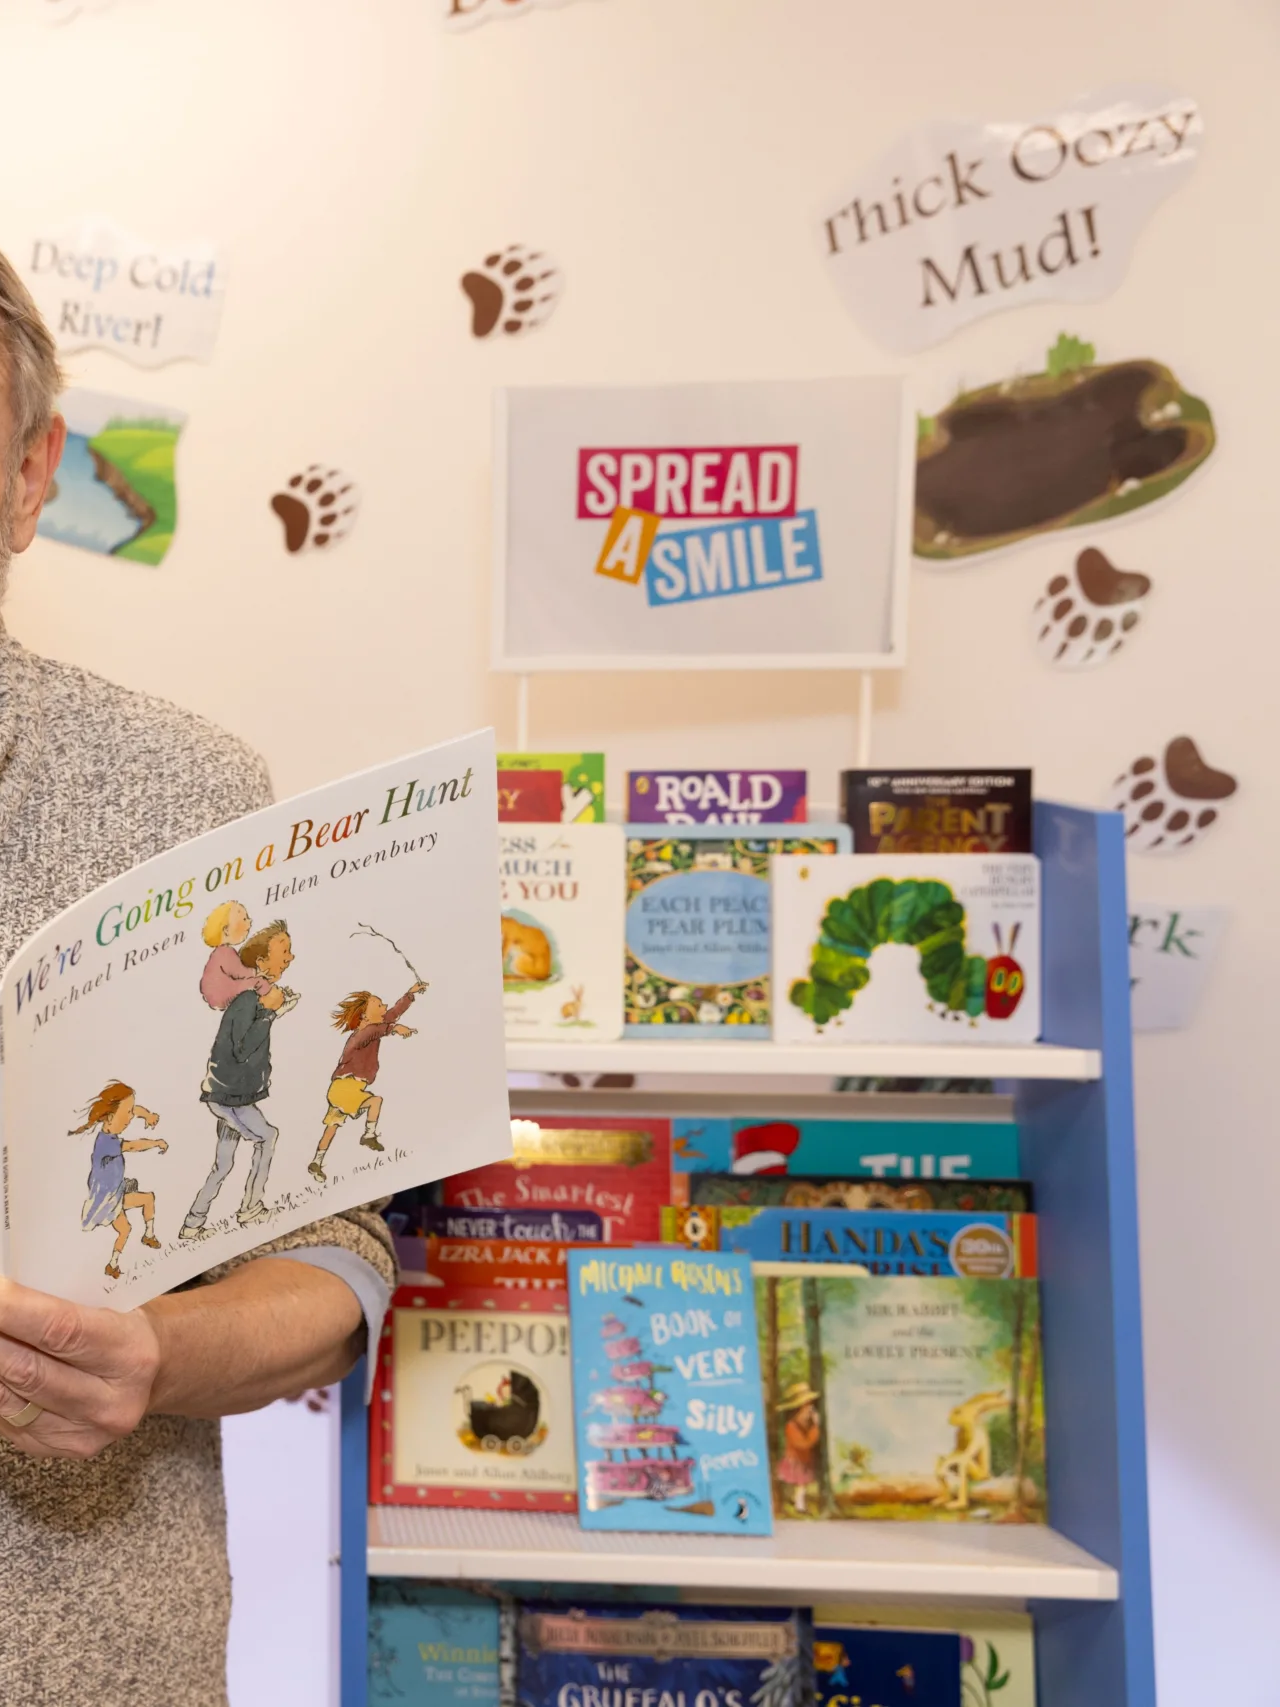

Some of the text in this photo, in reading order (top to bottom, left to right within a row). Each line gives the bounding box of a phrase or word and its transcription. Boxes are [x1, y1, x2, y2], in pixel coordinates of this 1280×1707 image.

[1010, 110, 1197, 183] Oozy
[31, 238, 217, 298] Deep Cold
[918, 203, 1104, 308] Mud!
[584, 451, 792, 515] SPREAD
[602, 514, 814, 600] A SMILE
[654, 772, 783, 811] ROALD
[868, 801, 1012, 836] PARENT
[13, 766, 475, 1016] We're Going on a Bear Hunt
[518, 881, 579, 901] YOU
[641, 896, 701, 914] EACH
[31, 830, 440, 1032] Michael Rosen Helen Oxenbury
[647, 918, 705, 936] PEAR
[515, 1175, 634, 1215] Smartest
[446, 1217, 497, 1237] NEVER
[503, 1212, 566, 1241] touch
[577, 1224, 597, 1239] THE
[781, 1220, 950, 1257] HANDA'S
[438, 1244, 494, 1264] EZRA
[495, 1246, 551, 1265] JACK
[420, 1318, 568, 1356] PEEPO!
[650, 1309, 718, 1346] BOOK
[674, 1345, 746, 1380] VERY
